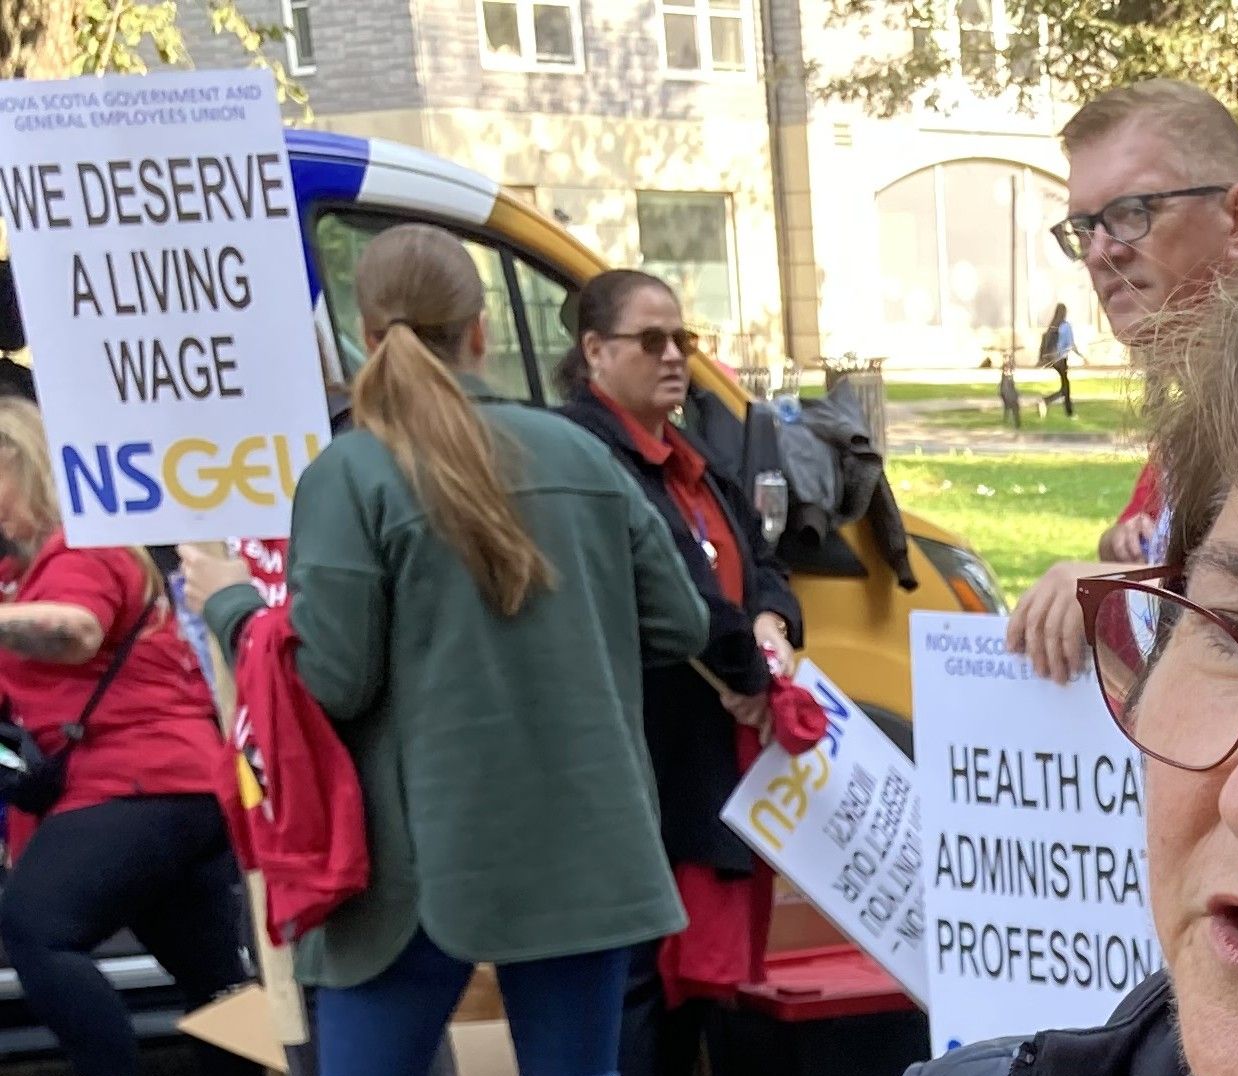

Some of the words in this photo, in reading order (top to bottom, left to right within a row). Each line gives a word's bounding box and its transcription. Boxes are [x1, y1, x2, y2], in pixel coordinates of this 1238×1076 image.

[14, 113, 86, 131] GENERAL
[90, 108, 187, 127] EMPLOYEES
[191, 105, 246, 122] UNION
[41, 92, 99, 110] SCOTIA
[103, 86, 219, 107] GOVERNMENT
[225, 85, 262, 101] AND
[0, 163, 72, 231] WE
[77, 153, 289, 226] DESERVE
[72, 252, 103, 317] A
[105, 245, 252, 316] LIVING
[104, 336, 243, 402] WAGE
[925, 633, 972, 653] NOVA
[975, 635, 1006, 655] SCO
[945, 658, 1016, 680] GENERAL
[949, 744, 1080, 813] HEALTH
[1094, 754, 1145, 816] CA
[834, 849, 877, 904] OUR
[935, 831, 1146, 906] ADMINISTRA
[937, 918, 1157, 992] PROFESSION
